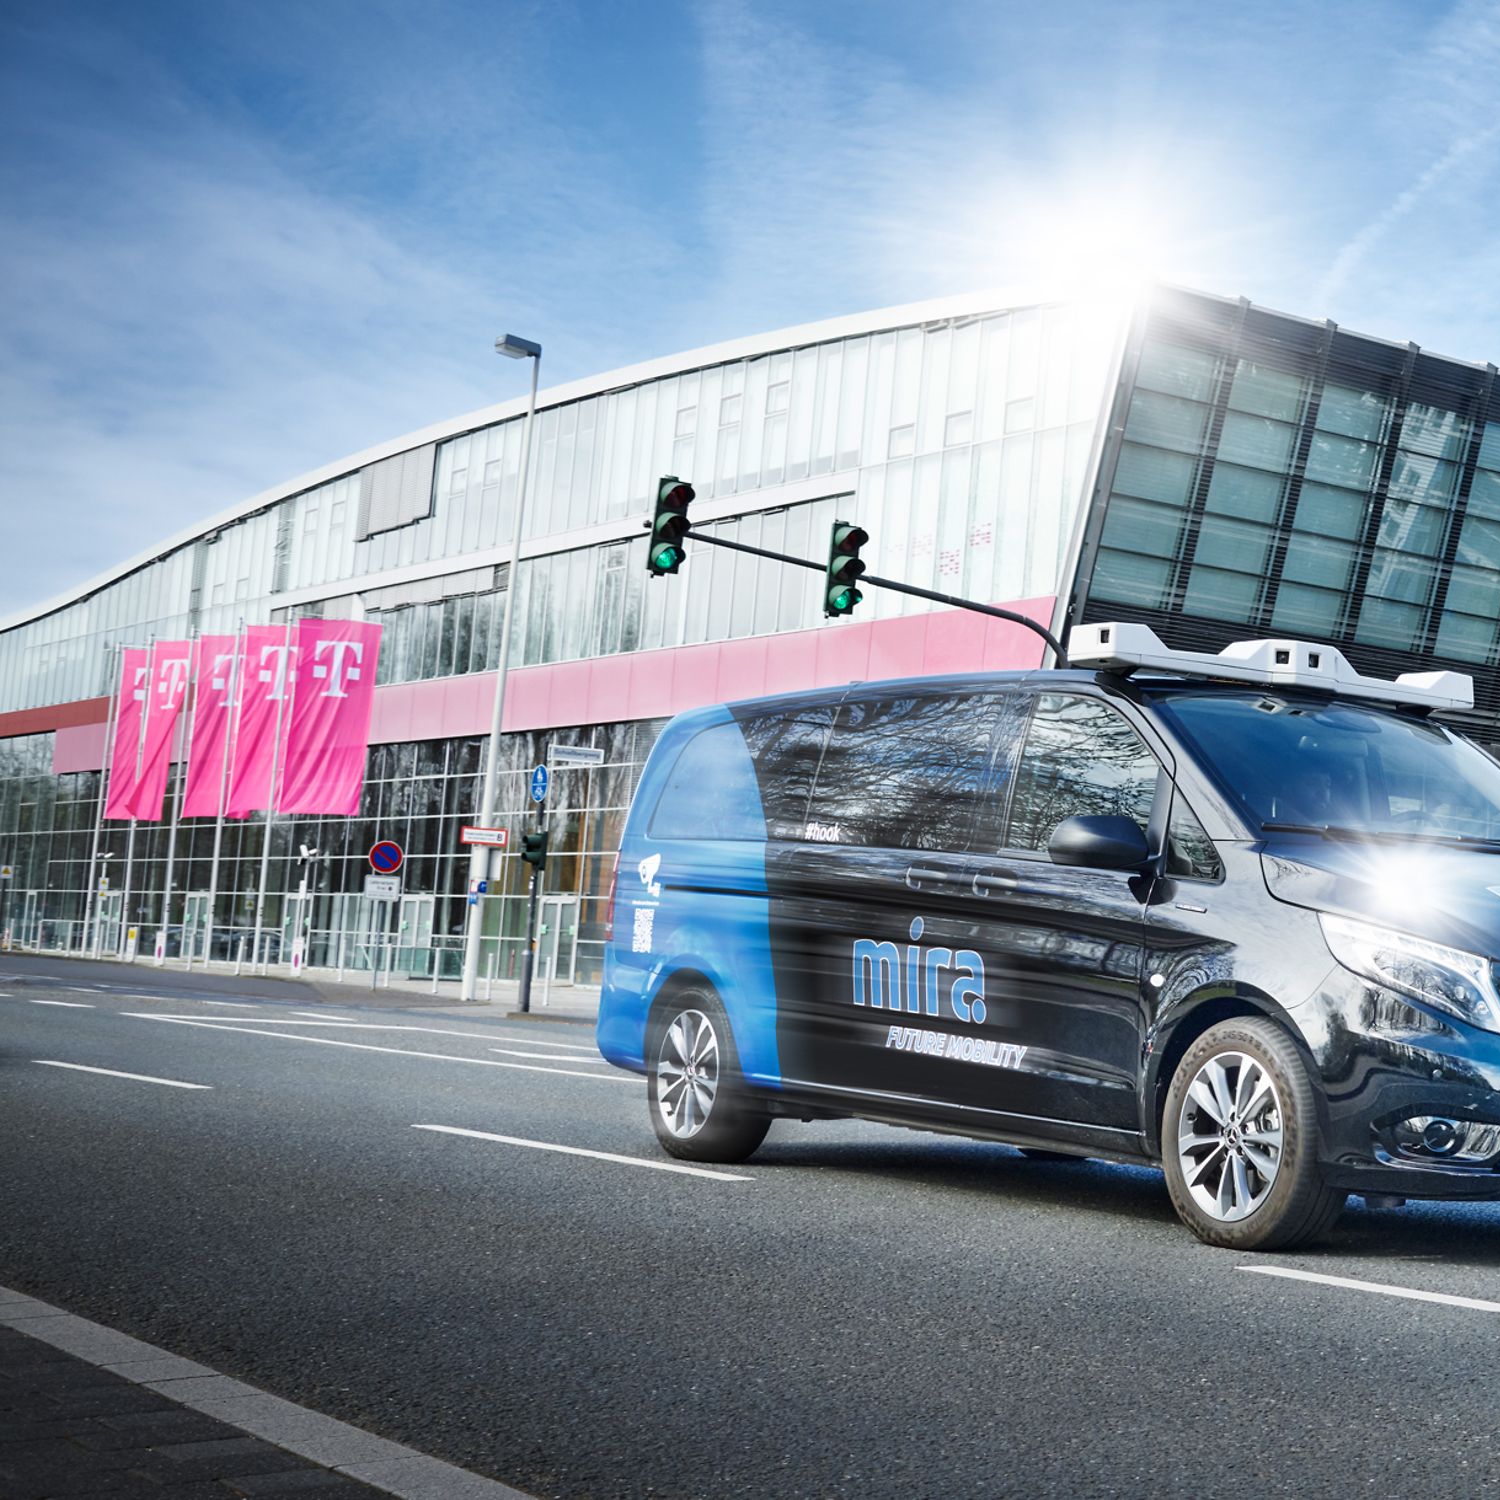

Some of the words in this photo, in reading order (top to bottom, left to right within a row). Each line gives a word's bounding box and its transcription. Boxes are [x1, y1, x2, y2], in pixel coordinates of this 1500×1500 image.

[805, 822, 840, 841] #hook
[853, 916, 987, 1024] mira
[886, 1025, 946, 1057] FUTURE
[945, 1034, 1028, 1070] MOBILITY
